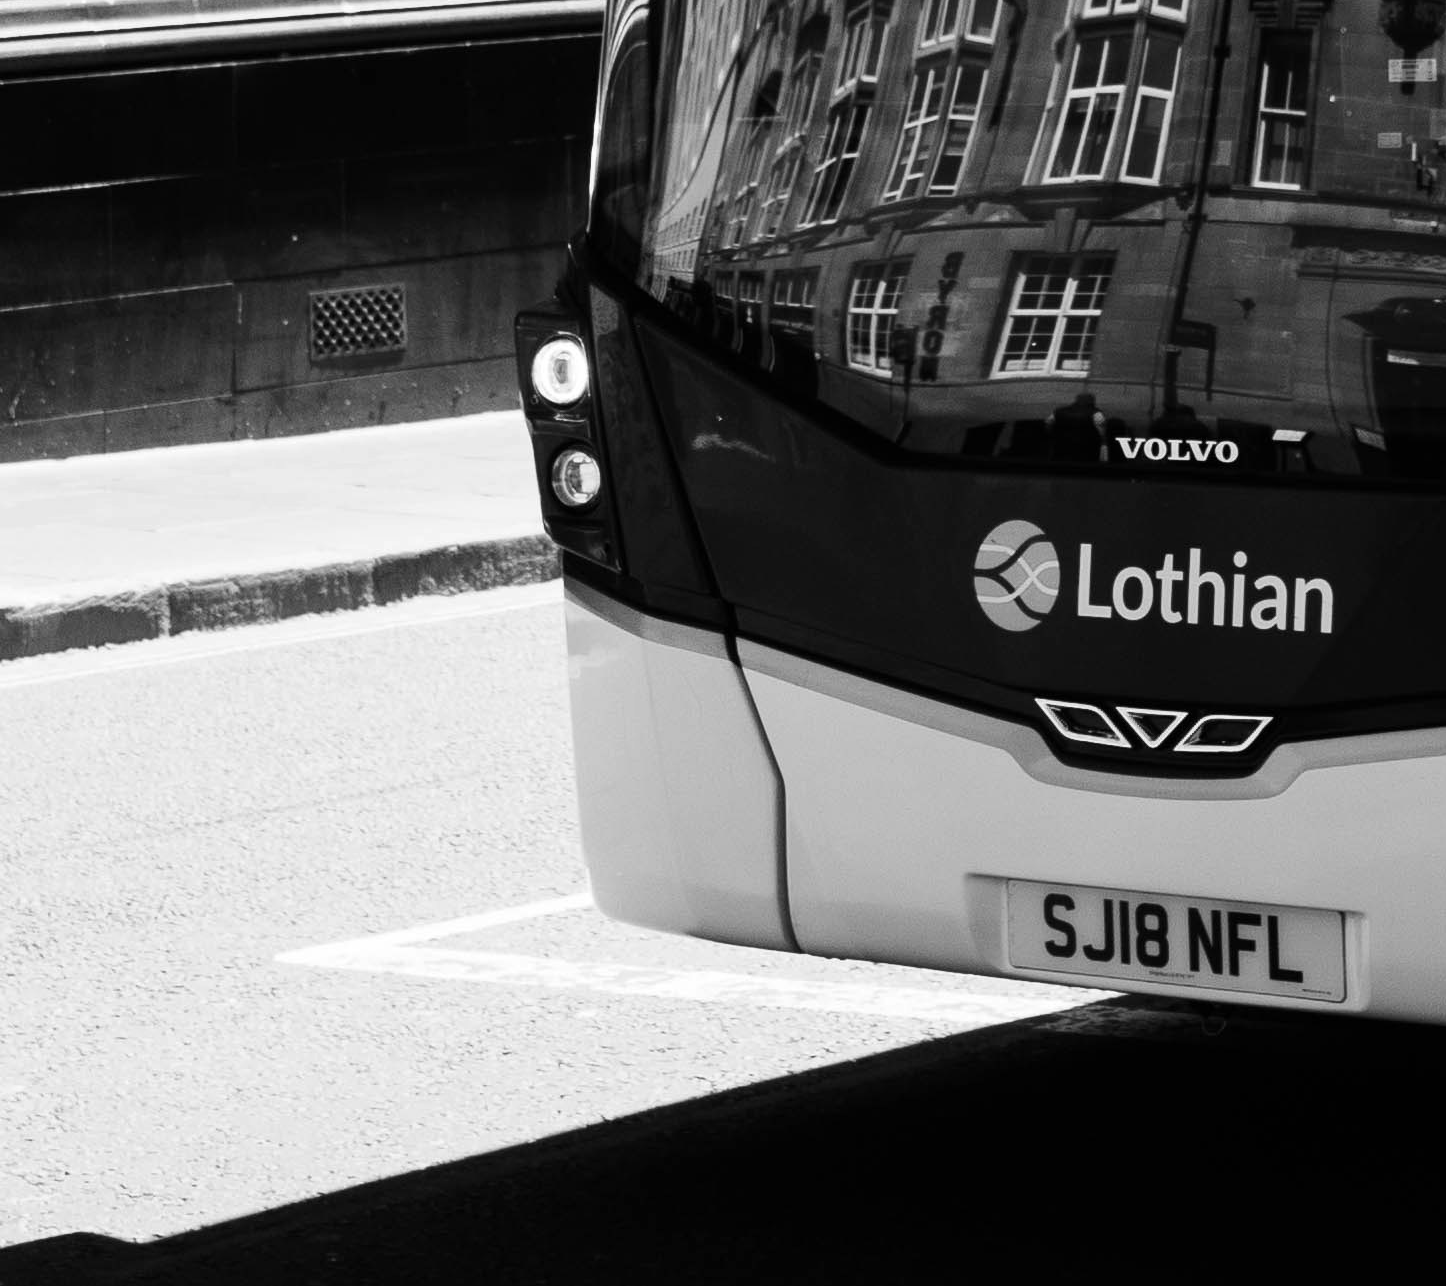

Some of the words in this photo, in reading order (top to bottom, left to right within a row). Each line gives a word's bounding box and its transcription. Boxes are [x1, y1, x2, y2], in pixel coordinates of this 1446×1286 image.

[1116, 437, 1239, 463] VOLVO
[1077, 543, 1334, 634] Lothian
[1043, 893, 1170, 969] SJ18
[1188, 907, 1304, 984] NFL
